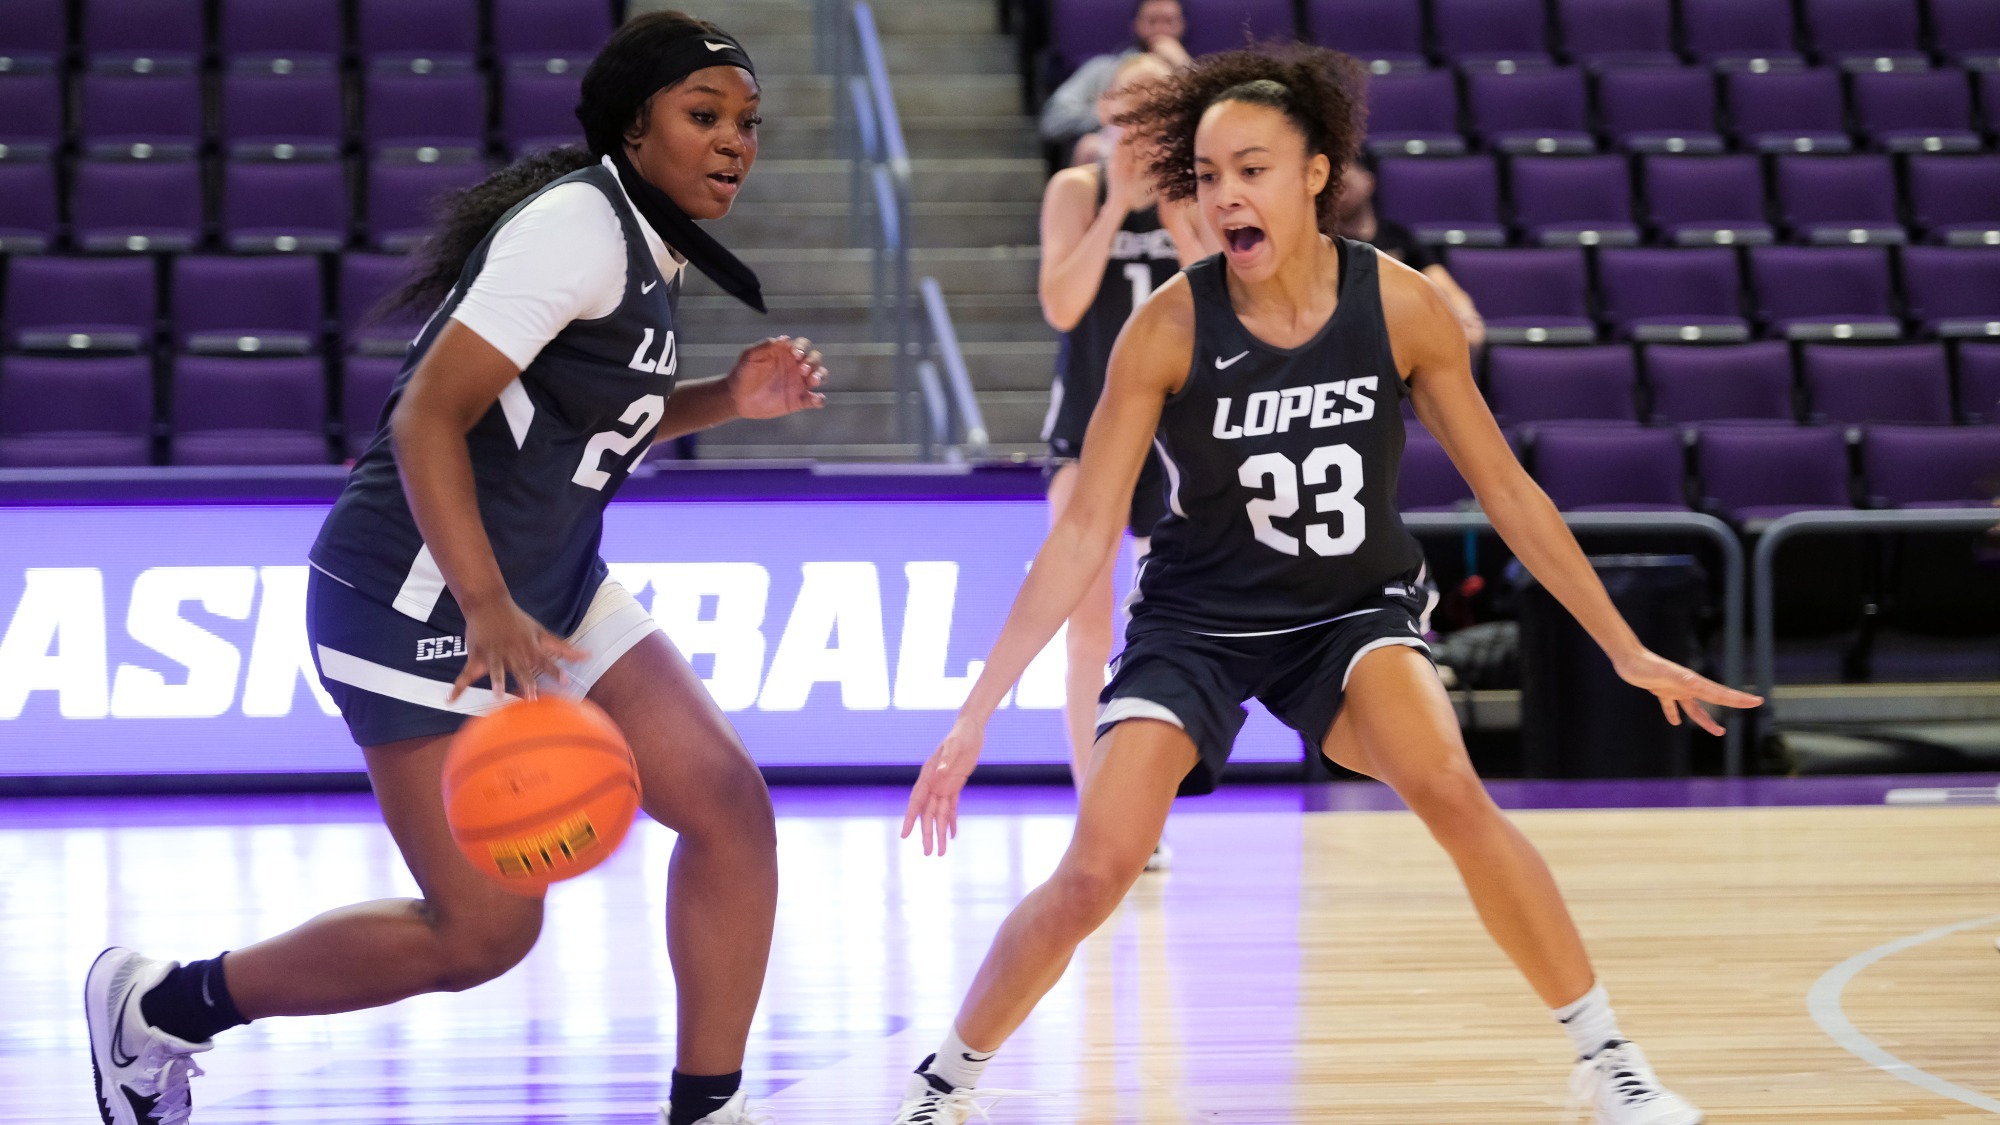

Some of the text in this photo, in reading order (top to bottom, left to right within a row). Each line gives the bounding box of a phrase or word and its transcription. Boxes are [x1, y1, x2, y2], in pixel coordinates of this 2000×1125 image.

[628, 327, 677, 376] LO
[571, 393, 666, 491] 2
[1212, 375, 1379, 440] LOPES
[1237, 442, 1366, 557] 23
